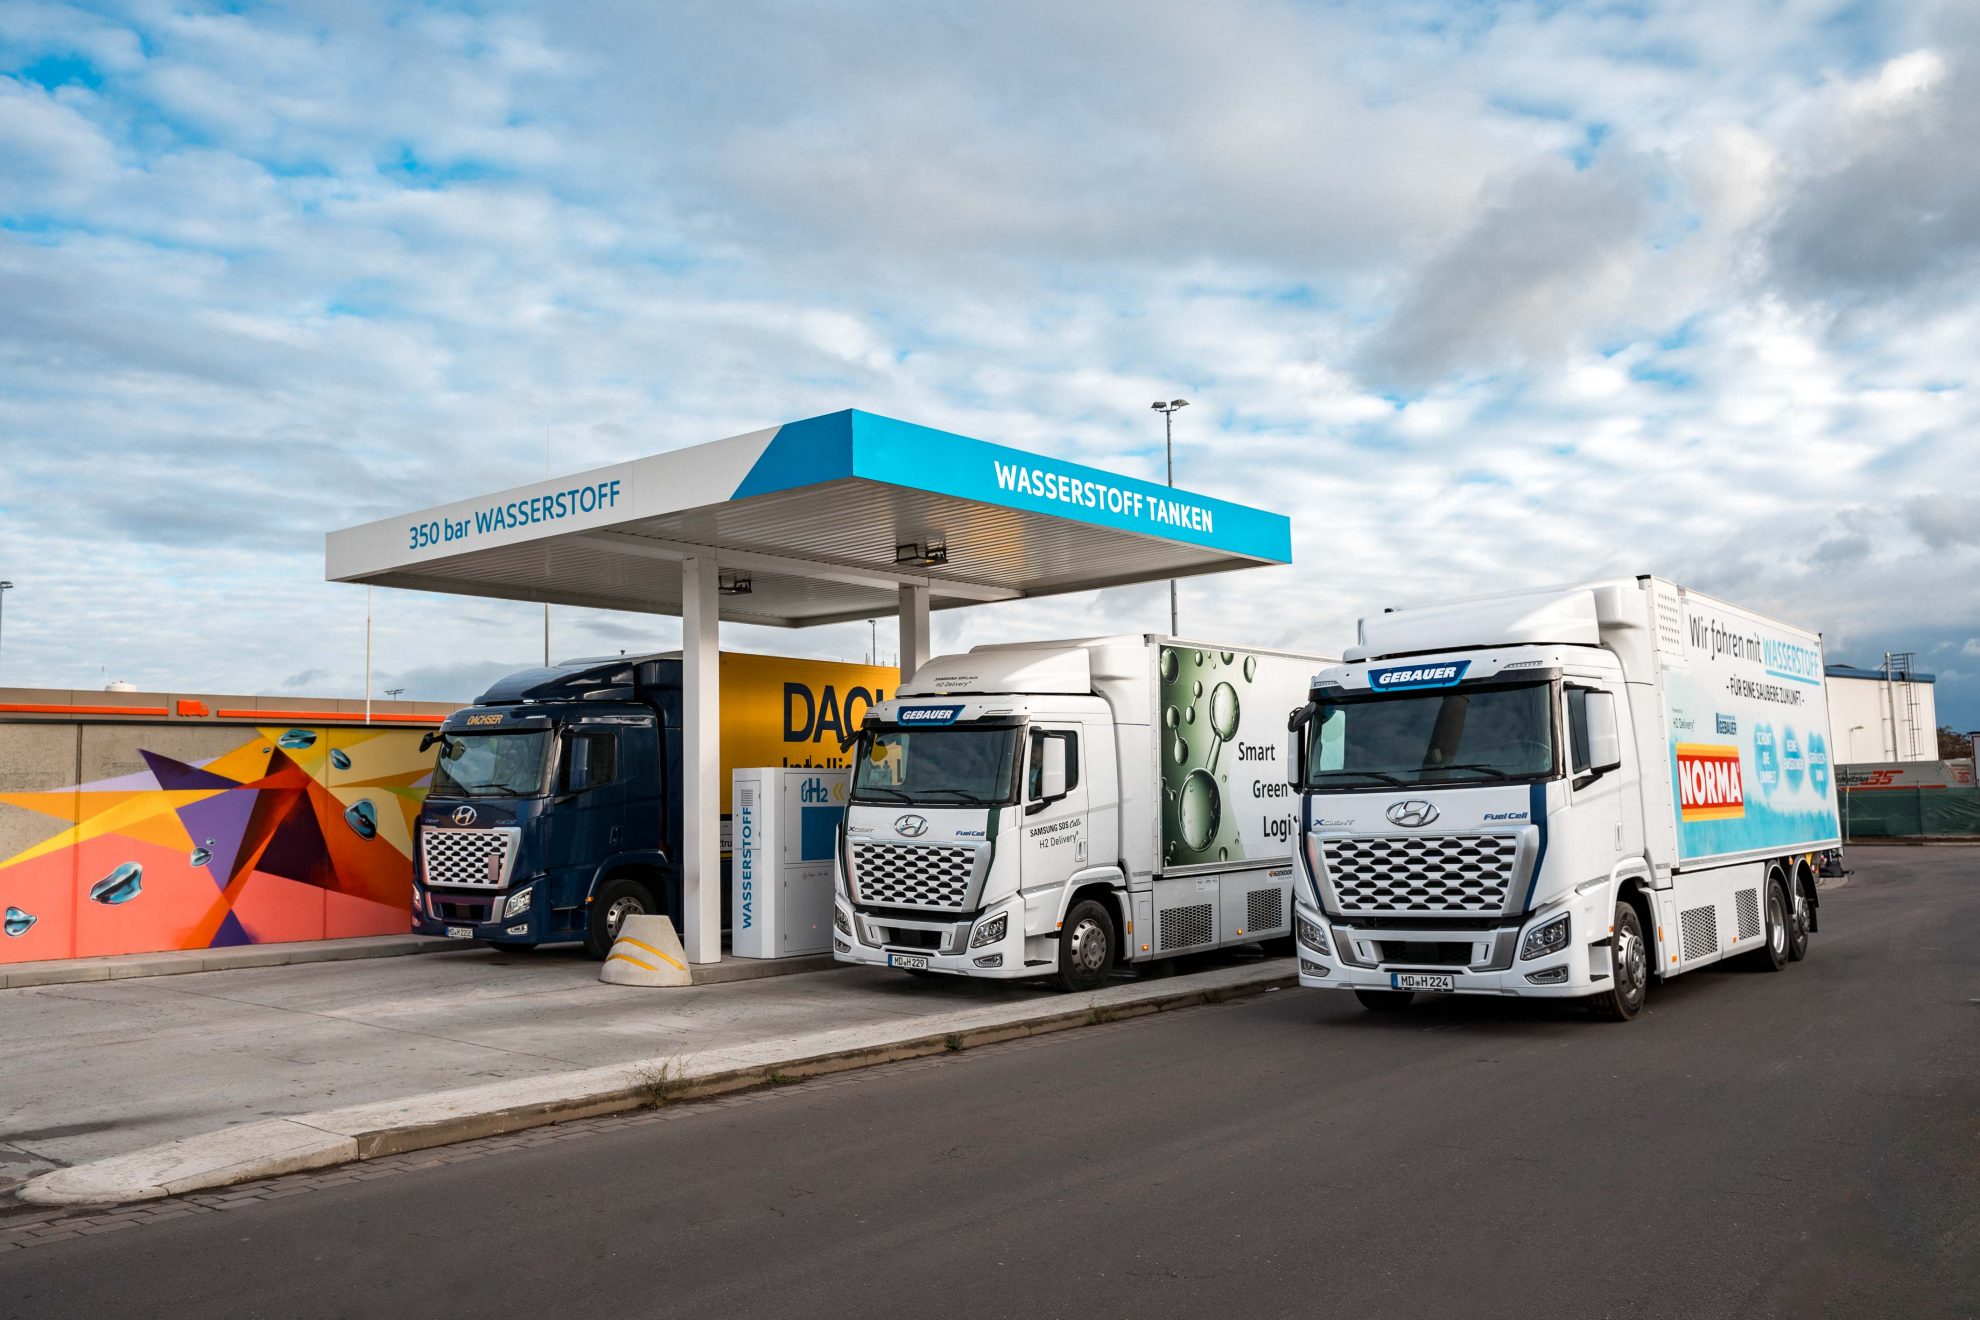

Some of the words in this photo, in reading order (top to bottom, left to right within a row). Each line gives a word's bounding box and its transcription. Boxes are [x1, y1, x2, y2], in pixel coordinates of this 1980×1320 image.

[993, 460, 1144, 518] WASSERSTOFF
[1146, 497, 1213, 534] TANKEN
[408, 521, 440, 550] 350
[443, 516, 471, 542] bar
[474, 480, 621, 535] WASSERSTOFF
[1689, 614, 1708, 650] Wir
[1711, 619, 1745, 661] fahren
[1746, 632, 1762, 663] mit
[1762, 637, 1818, 678] WASSERSTOFF
[1378, 667, 1457, 684] GEBAUER
[1743, 680, 1756, 699] EINE
[467, 714, 503, 726] DACHSER
[783, 682, 884, 744] DAC
[902, 709, 954, 720] GEBAUER
[1238, 742, 1276, 761] Smart
[1252, 779, 1288, 798] Green
[1678, 759, 1742, 806] NORMA
[1484, 812, 1508, 820] Fuel
[1030, 824, 1058, 837] SAMSUNG
[1058, 821, 1069, 831] SDS
[1040, 838, 1049, 849] H2
[742, 807, 752, 929] WASSERSTOFF
[894, 956, 904, 966] MD
[912, 958, 925, 968] 229
[1401, 975, 1415, 986] MD
[1430, 976, 1449, 988] 224
